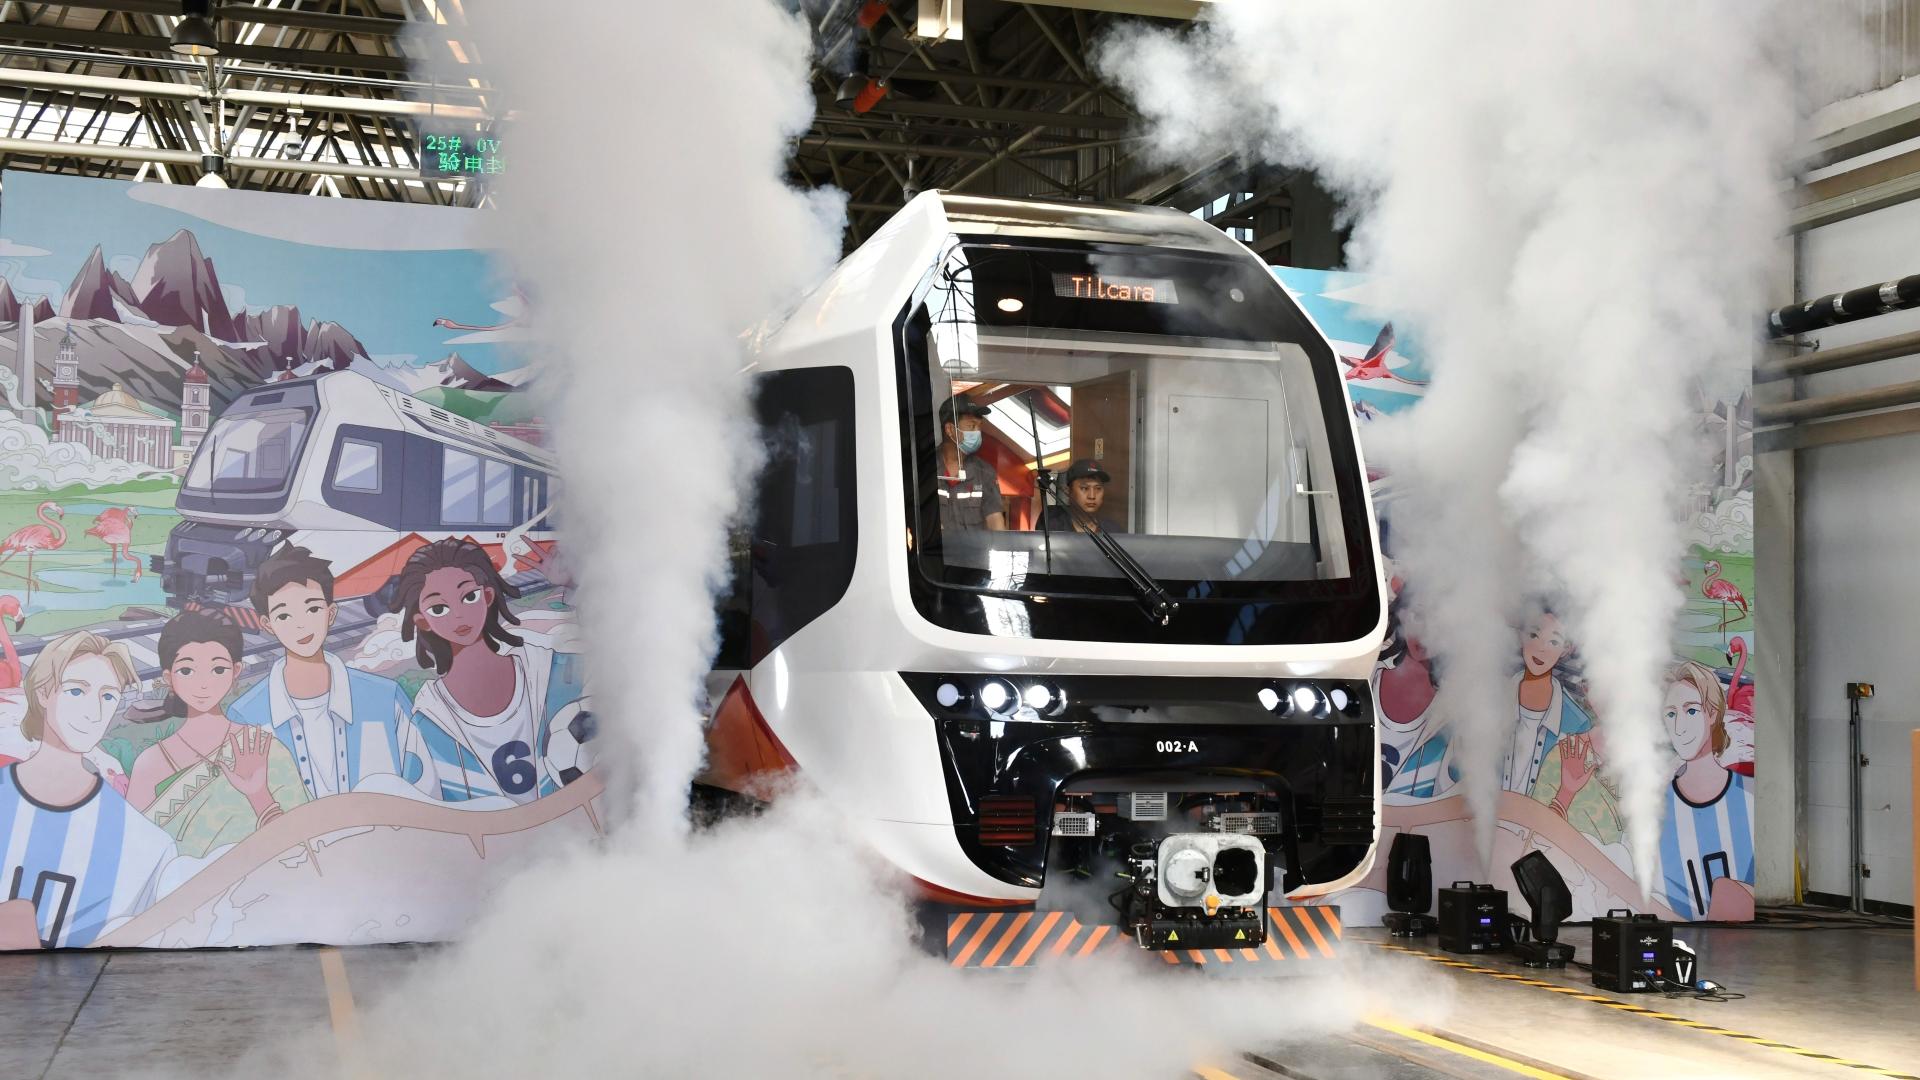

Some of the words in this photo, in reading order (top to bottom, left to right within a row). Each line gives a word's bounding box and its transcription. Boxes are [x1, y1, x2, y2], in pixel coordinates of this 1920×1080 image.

[426, 135, 461, 151] 25#
[1071, 276, 1155, 301] Tilcara
[491, 740, 538, 795] 6
